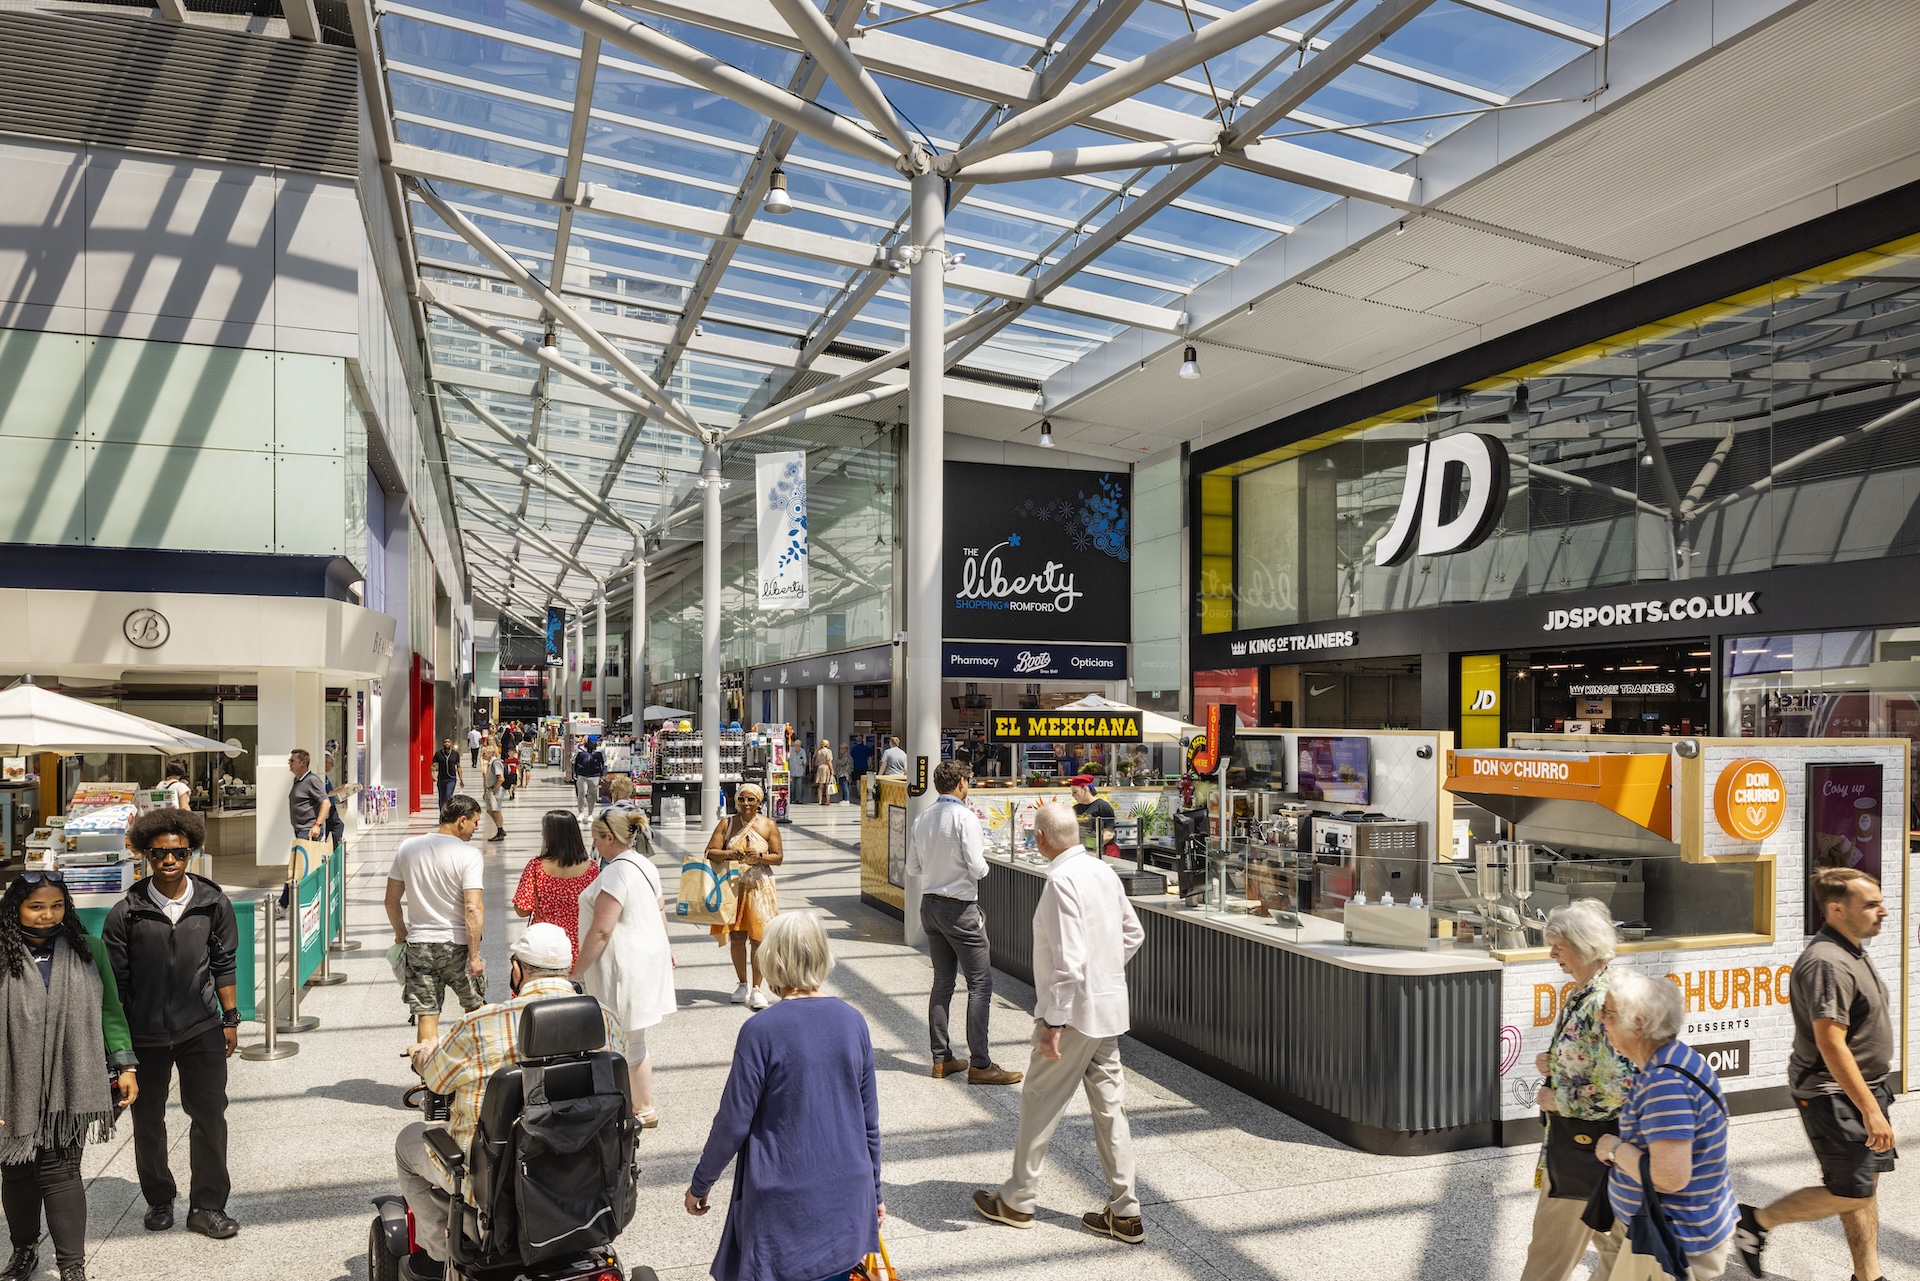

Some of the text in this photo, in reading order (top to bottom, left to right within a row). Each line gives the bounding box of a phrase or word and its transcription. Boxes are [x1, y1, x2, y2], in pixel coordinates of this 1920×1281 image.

[1375, 432, 1492, 566] JD
[963, 548, 979, 556] THE
[762, 576, 807, 598] liberty
[956, 542, 1083, 612] liberty
[956, 600, 1054, 612] SHOPPING ROMFORD
[1543, 591, 1756, 631] JDSPORTS.CO.UK
[1248, 630, 1353, 654] KING OF TRAINERS
[950, 651, 1114, 673] Pharmacy Boots Opticians
[1584, 684, 1608, 695] KING
[1620, 683, 1676, 695] TRAINERS
[1471, 689, 1497, 711] JD
[995, 717, 1140, 737] EL MEXICANA
[1193, 758, 1208, 768] HERE
[1473, 758, 1569, 780] DON CHURRO
[1745, 772, 1769, 788] DON
[1822, 780, 1866, 797] Cosy up
[1734, 788, 1780, 804] CHURRO
[1663, 964, 1793, 1014] HURRO
[1688, 1019, 1750, 1034] DESSERTS
